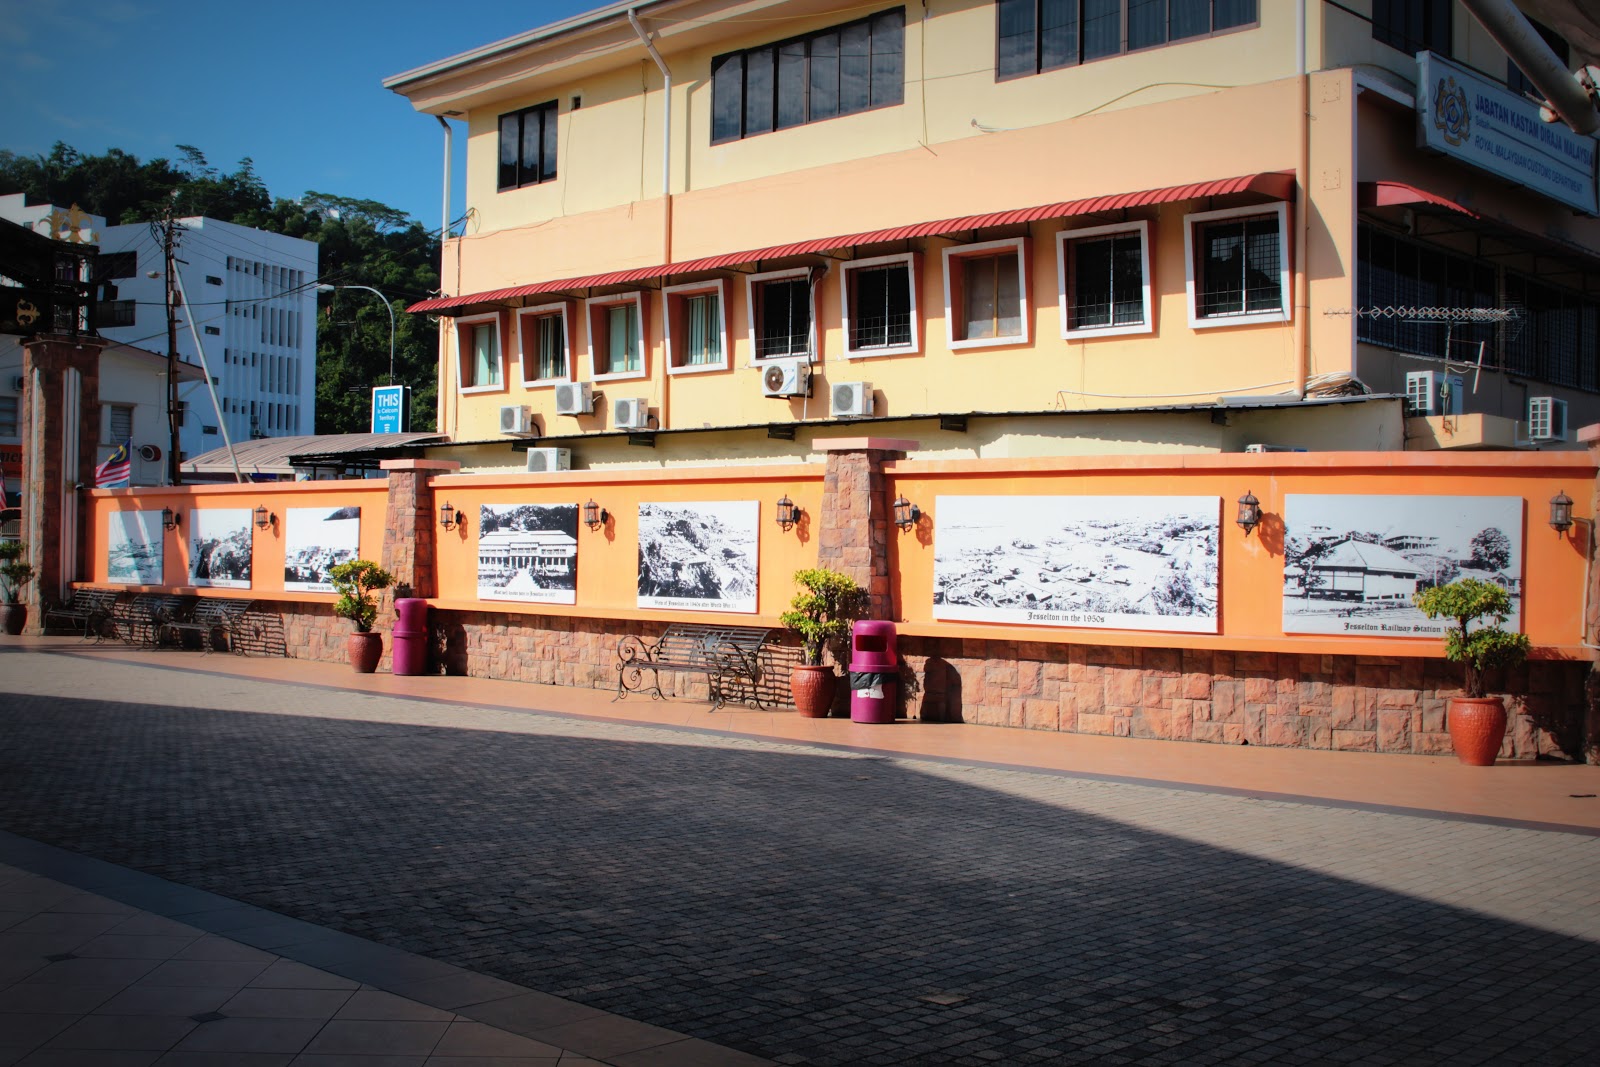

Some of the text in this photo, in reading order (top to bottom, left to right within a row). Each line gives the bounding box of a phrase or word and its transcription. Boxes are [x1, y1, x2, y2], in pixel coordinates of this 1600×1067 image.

[1475, 94, 1594, 169] JABATAN KASTAM DIRAJA MALAYSIA
[1474, 135, 1583, 193] ROYAL MALAYSIAN CUSTOMS DEPARTMENT
[378, 393, 399, 407] THIS
[1027, 612, 1060, 621] Jesselton
[1070, 614, 1081, 623] the
[1083, 614, 1105, 623] 1950s
[1343, 622, 1378, 631] Jesselton
[1380, 624, 1412, 634] Railway
[1412, 624, 1441, 632] Station
